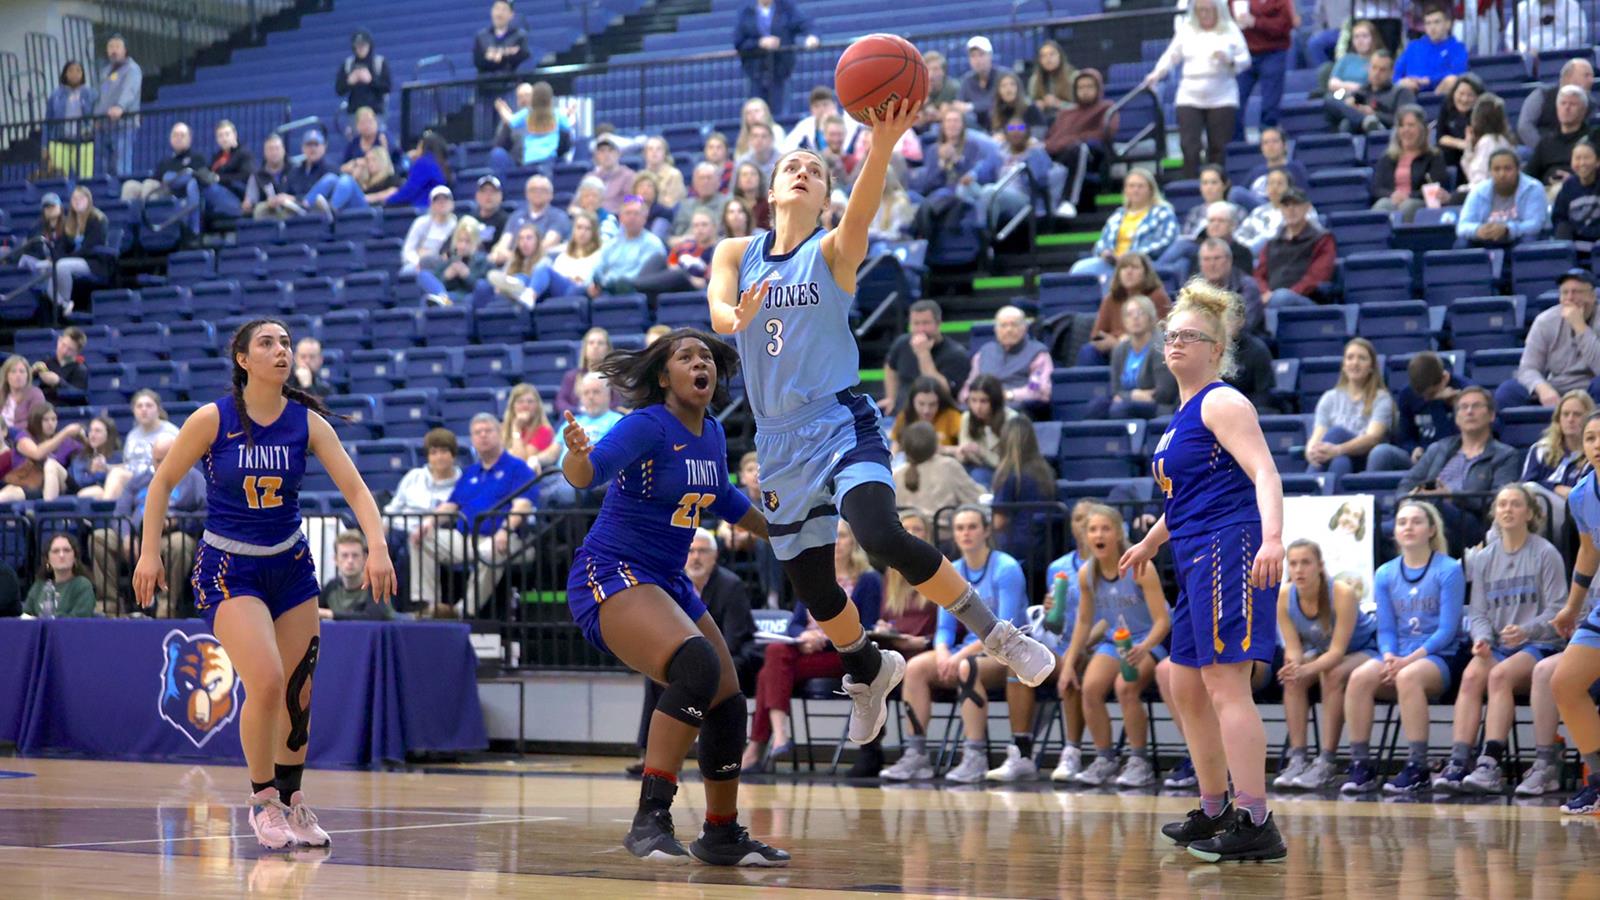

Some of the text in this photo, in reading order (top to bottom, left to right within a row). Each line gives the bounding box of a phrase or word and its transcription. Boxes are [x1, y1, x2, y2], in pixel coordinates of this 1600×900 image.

[764, 282, 820, 309] JONES
[764, 317, 785, 357] 3
[238, 444, 290, 470] TRINITY
[684, 458, 719, 487] TRINITY
[242, 475, 284, 509] 12
[1408, 616, 1422, 635] 2
